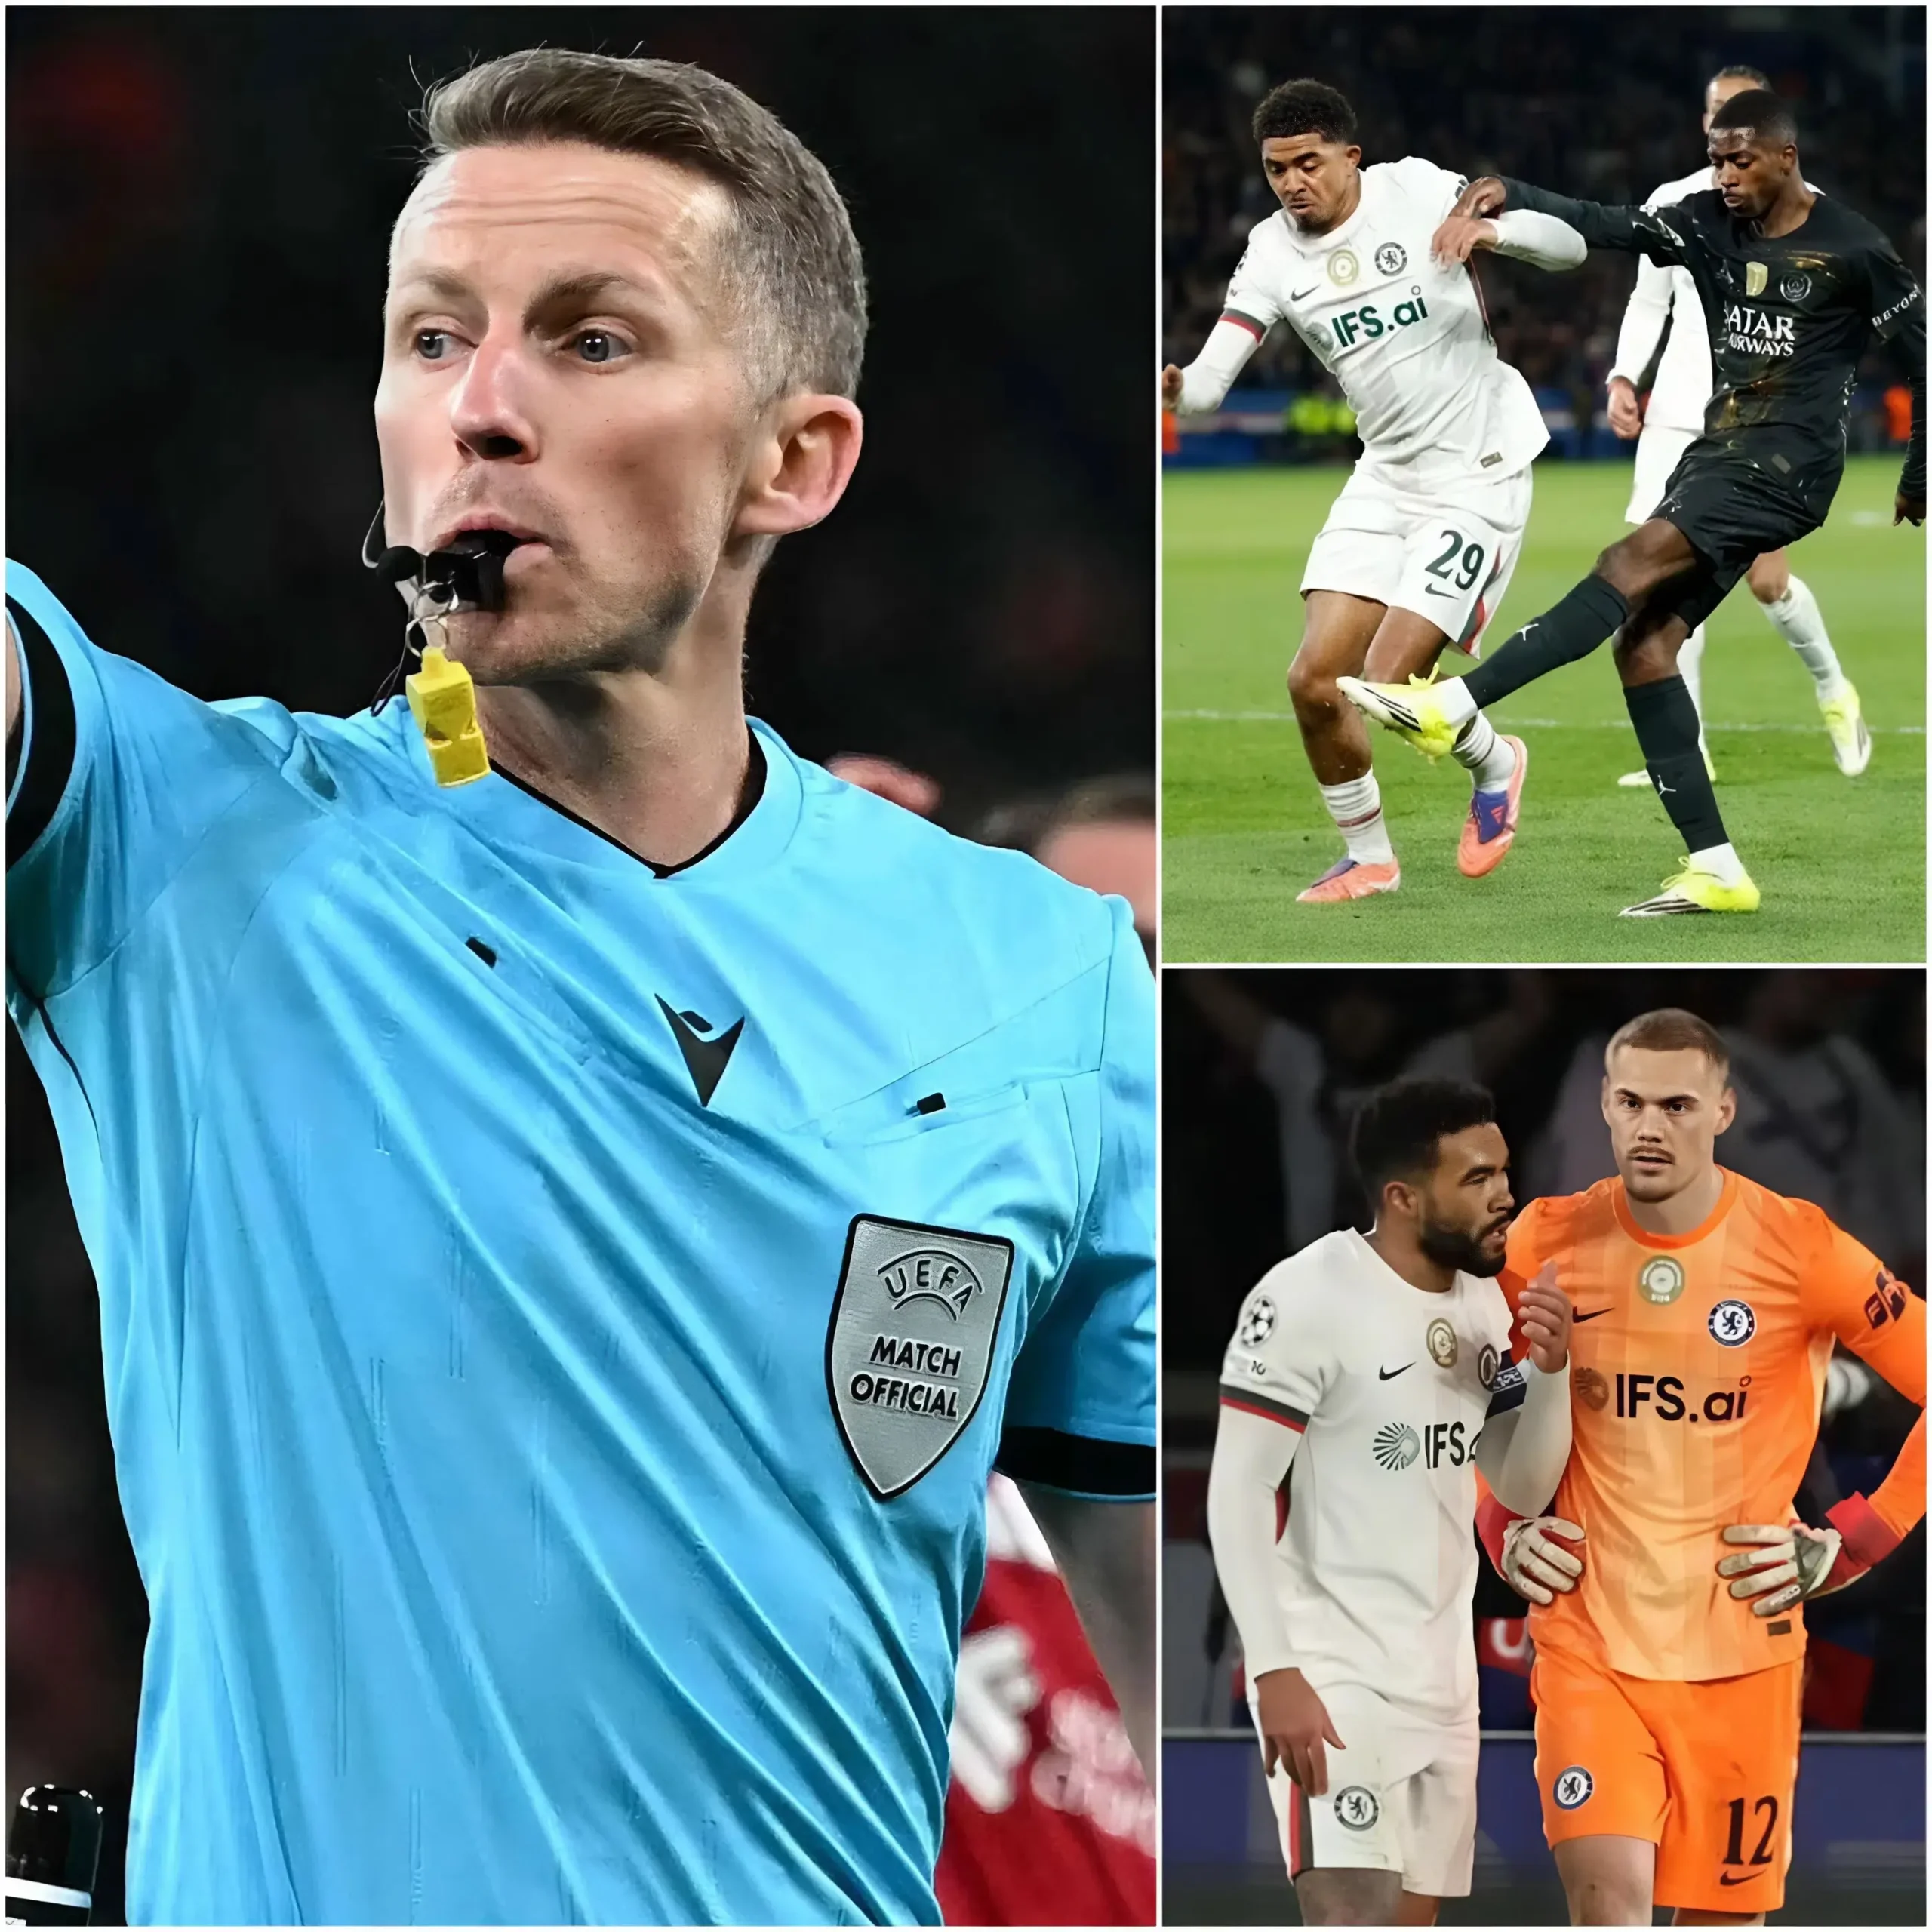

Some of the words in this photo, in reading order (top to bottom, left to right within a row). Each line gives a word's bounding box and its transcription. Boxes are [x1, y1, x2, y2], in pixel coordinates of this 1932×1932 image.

[1331, 285, 1429, 348] IFS.ai
[1724, 305, 1795, 341] ATAR
[1424, 529, 1485, 591] 29
[884, 1260, 974, 1314] UEFA
[869, 1335, 961, 1377] MATCH
[850, 1373, 958, 1417] OFFICIAL
[1615, 1374, 1752, 1423] IFS.ai
[1721, 1795, 1778, 1866] 12
